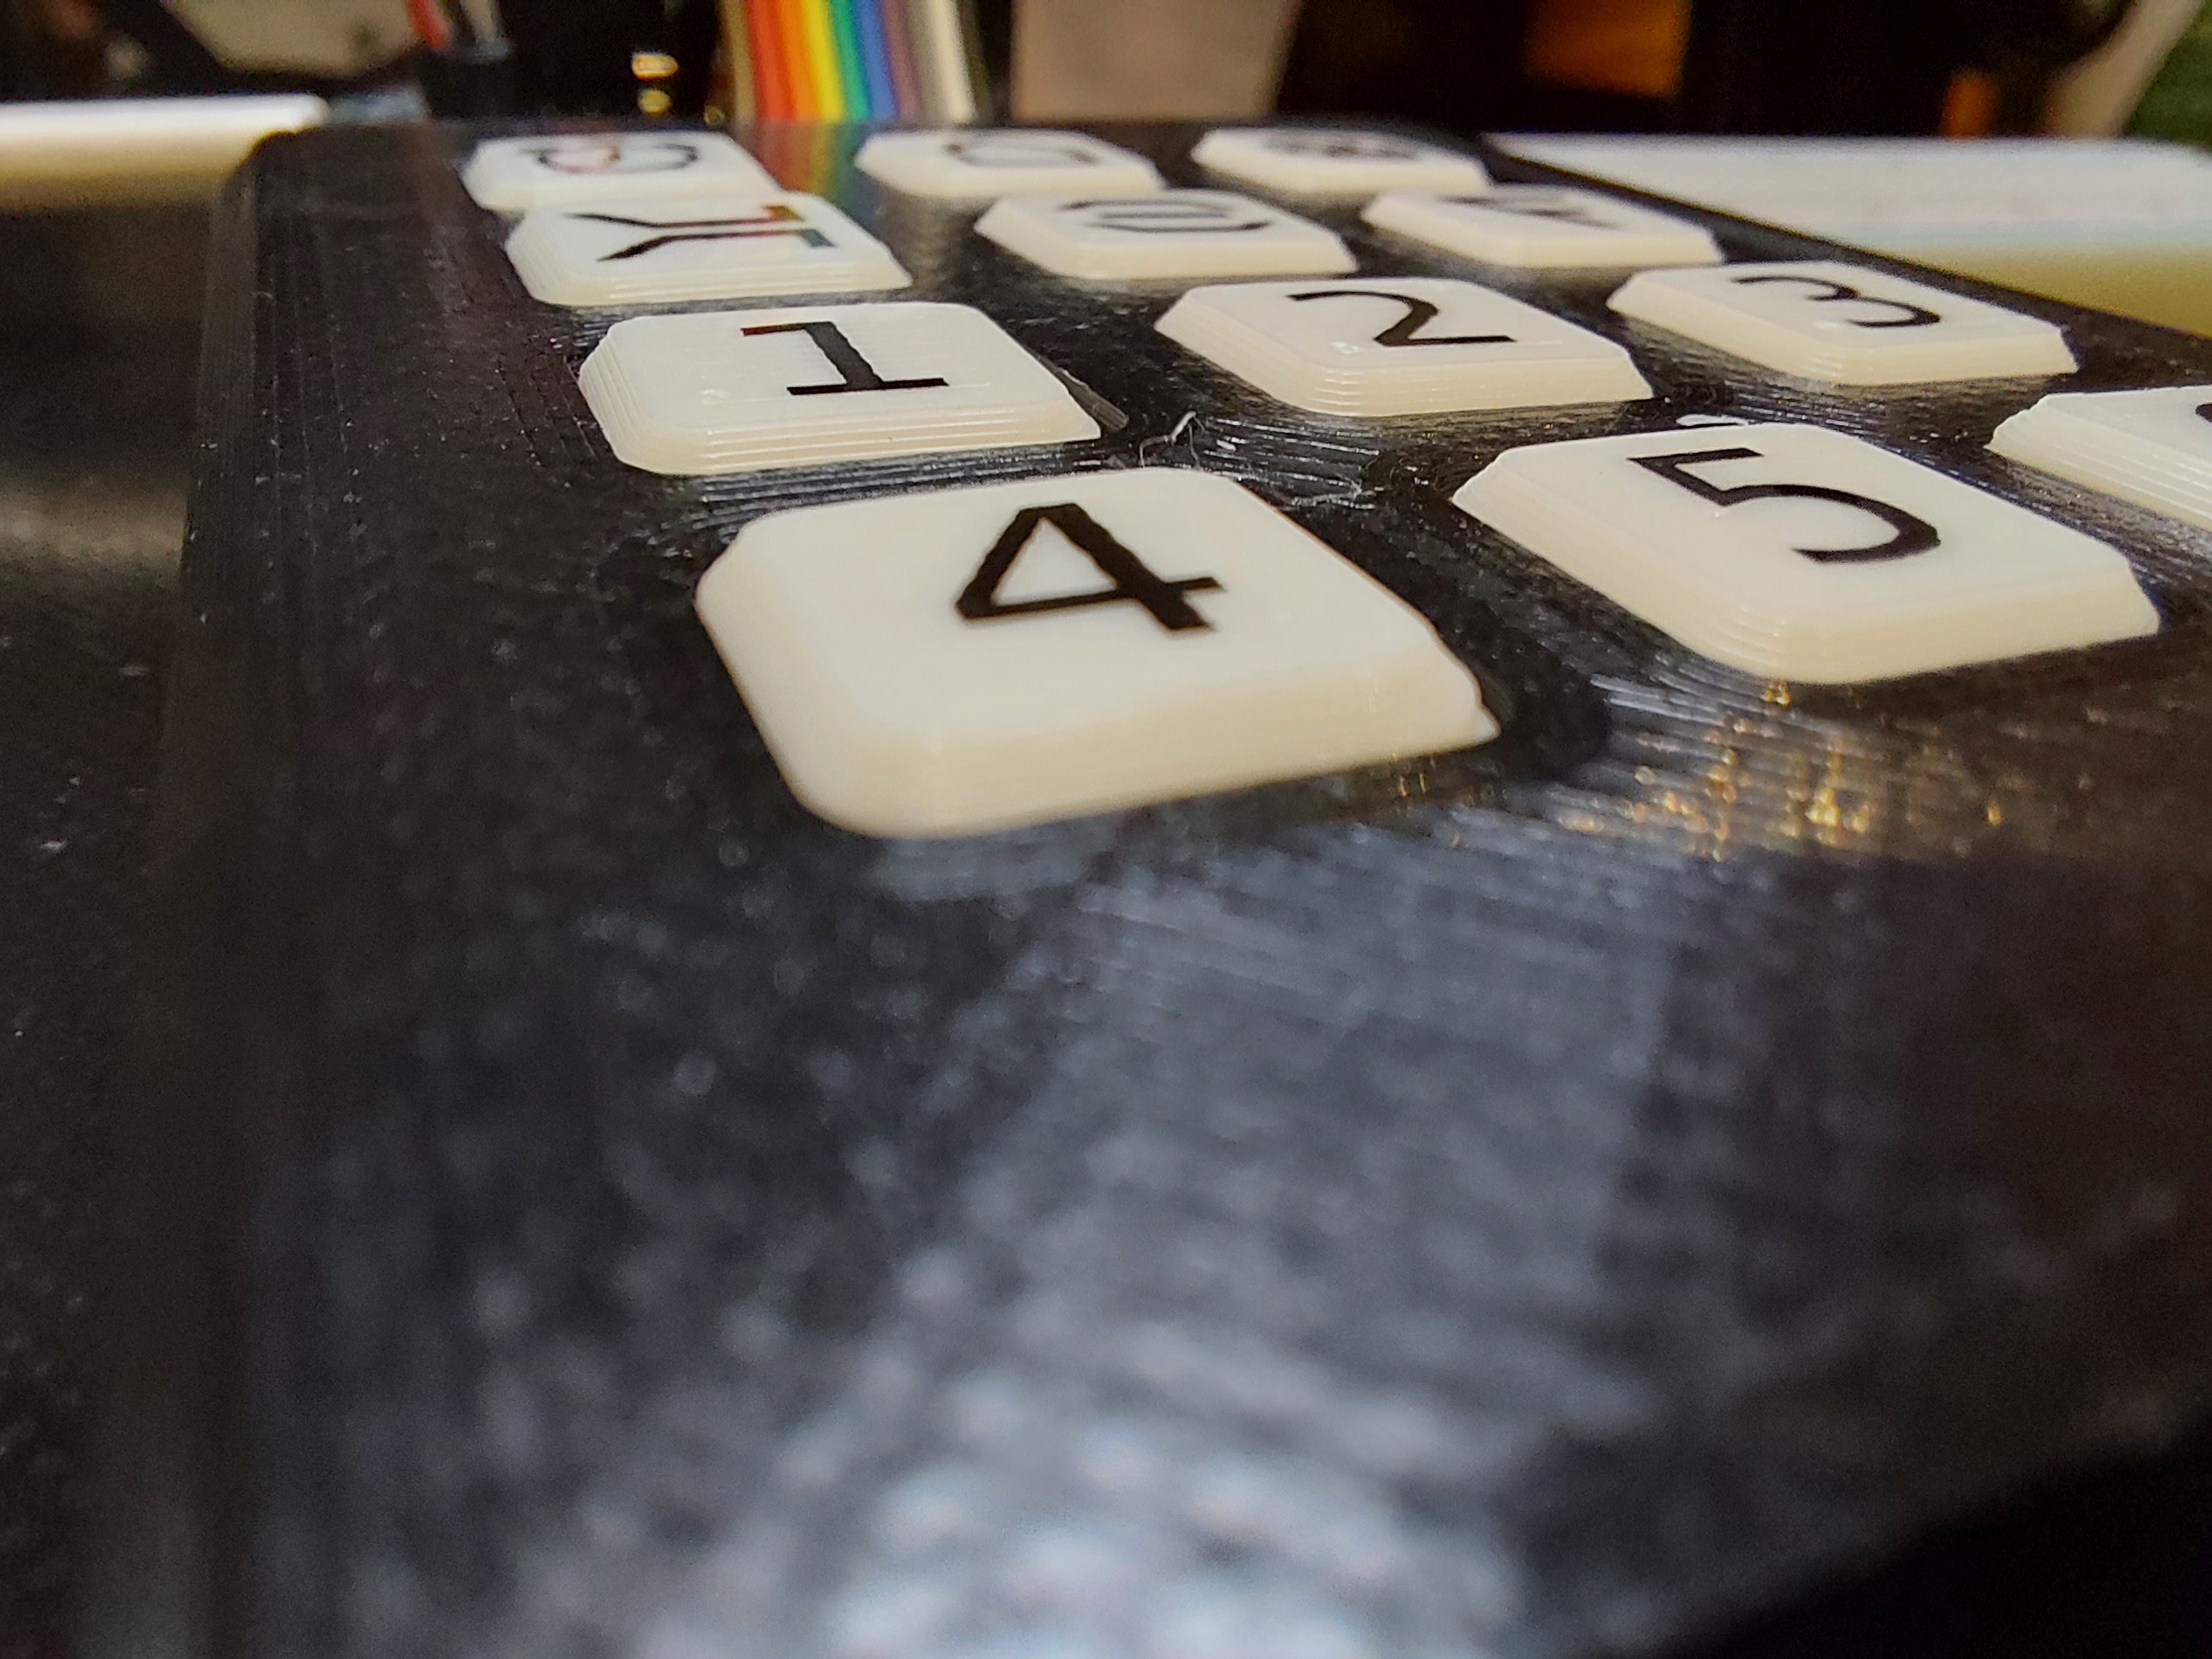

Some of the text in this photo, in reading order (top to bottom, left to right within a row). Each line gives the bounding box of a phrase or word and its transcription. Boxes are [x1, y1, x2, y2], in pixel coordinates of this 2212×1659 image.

[1286, 290, 1516, 347] 2
[1730, 276, 1941, 327] 3
[739, 321, 950, 395] 1
[1627, 447, 1941, 563] 5
[956, 502, 1222, 630] 4
